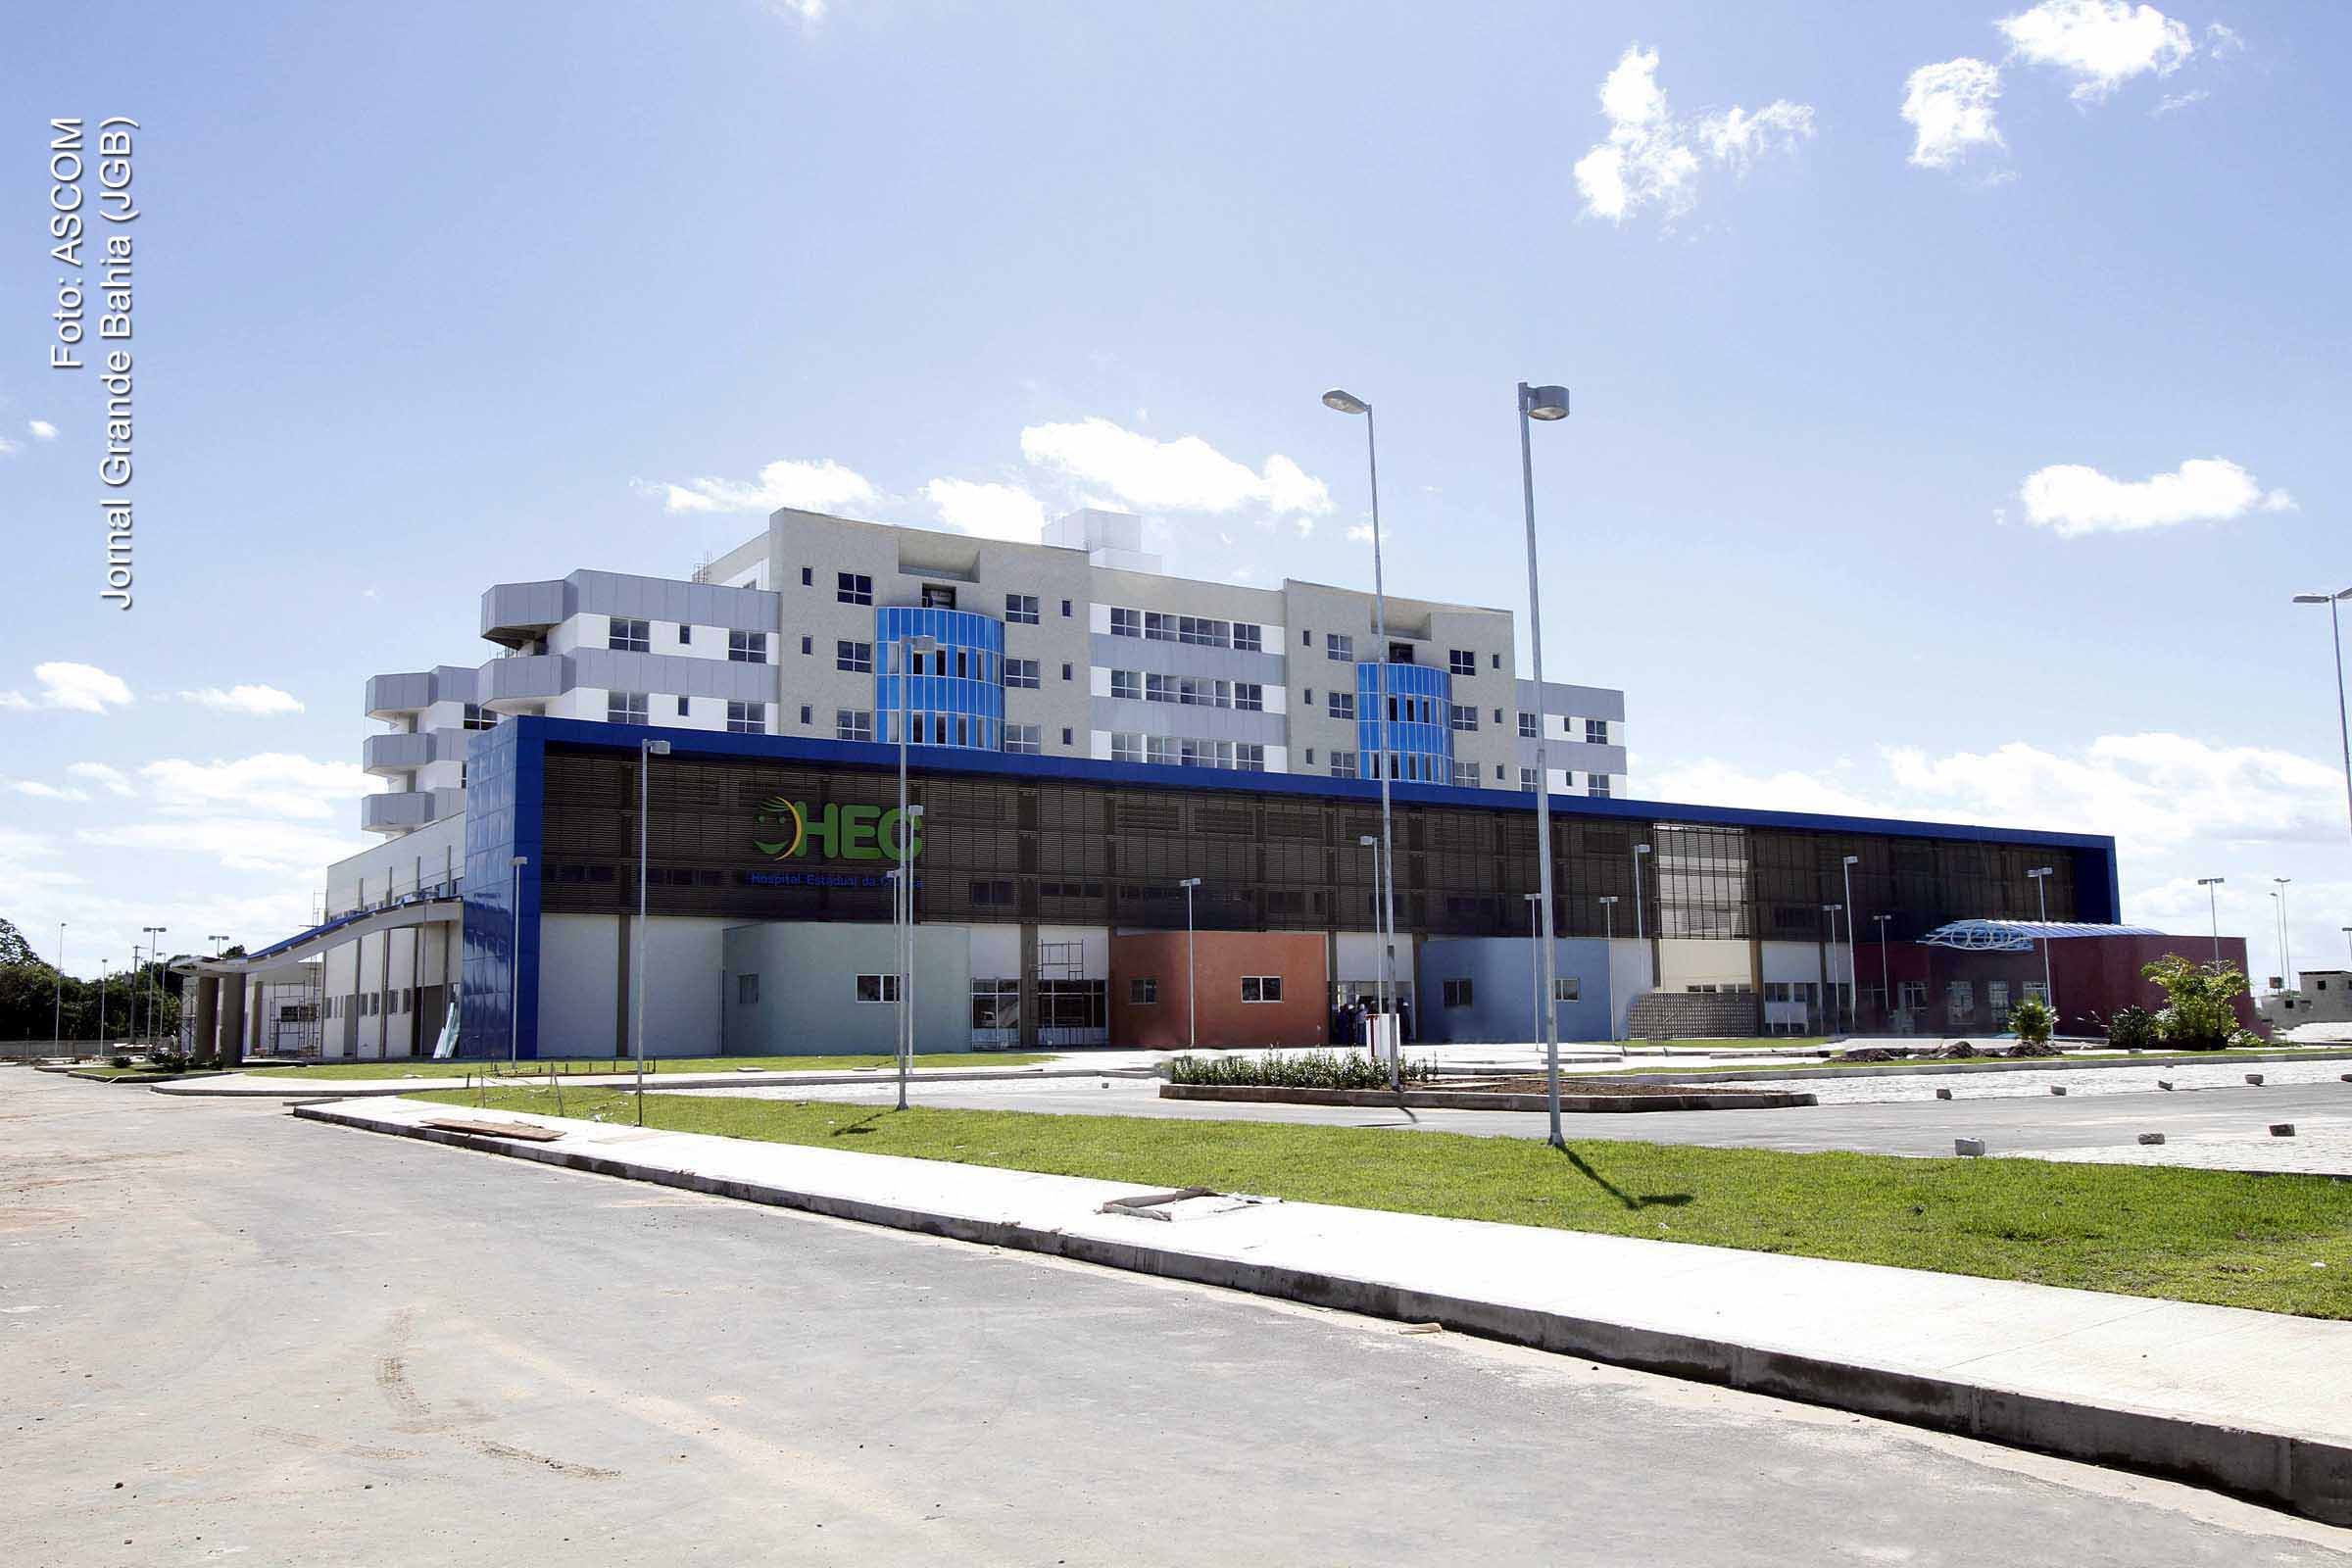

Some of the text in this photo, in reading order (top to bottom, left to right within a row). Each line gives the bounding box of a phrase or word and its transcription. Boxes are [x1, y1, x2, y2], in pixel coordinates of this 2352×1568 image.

[794, 801, 923, 860] HEC
[752, 871, 800, 887] Hospital
[807, 873, 858, 887] Estadual
